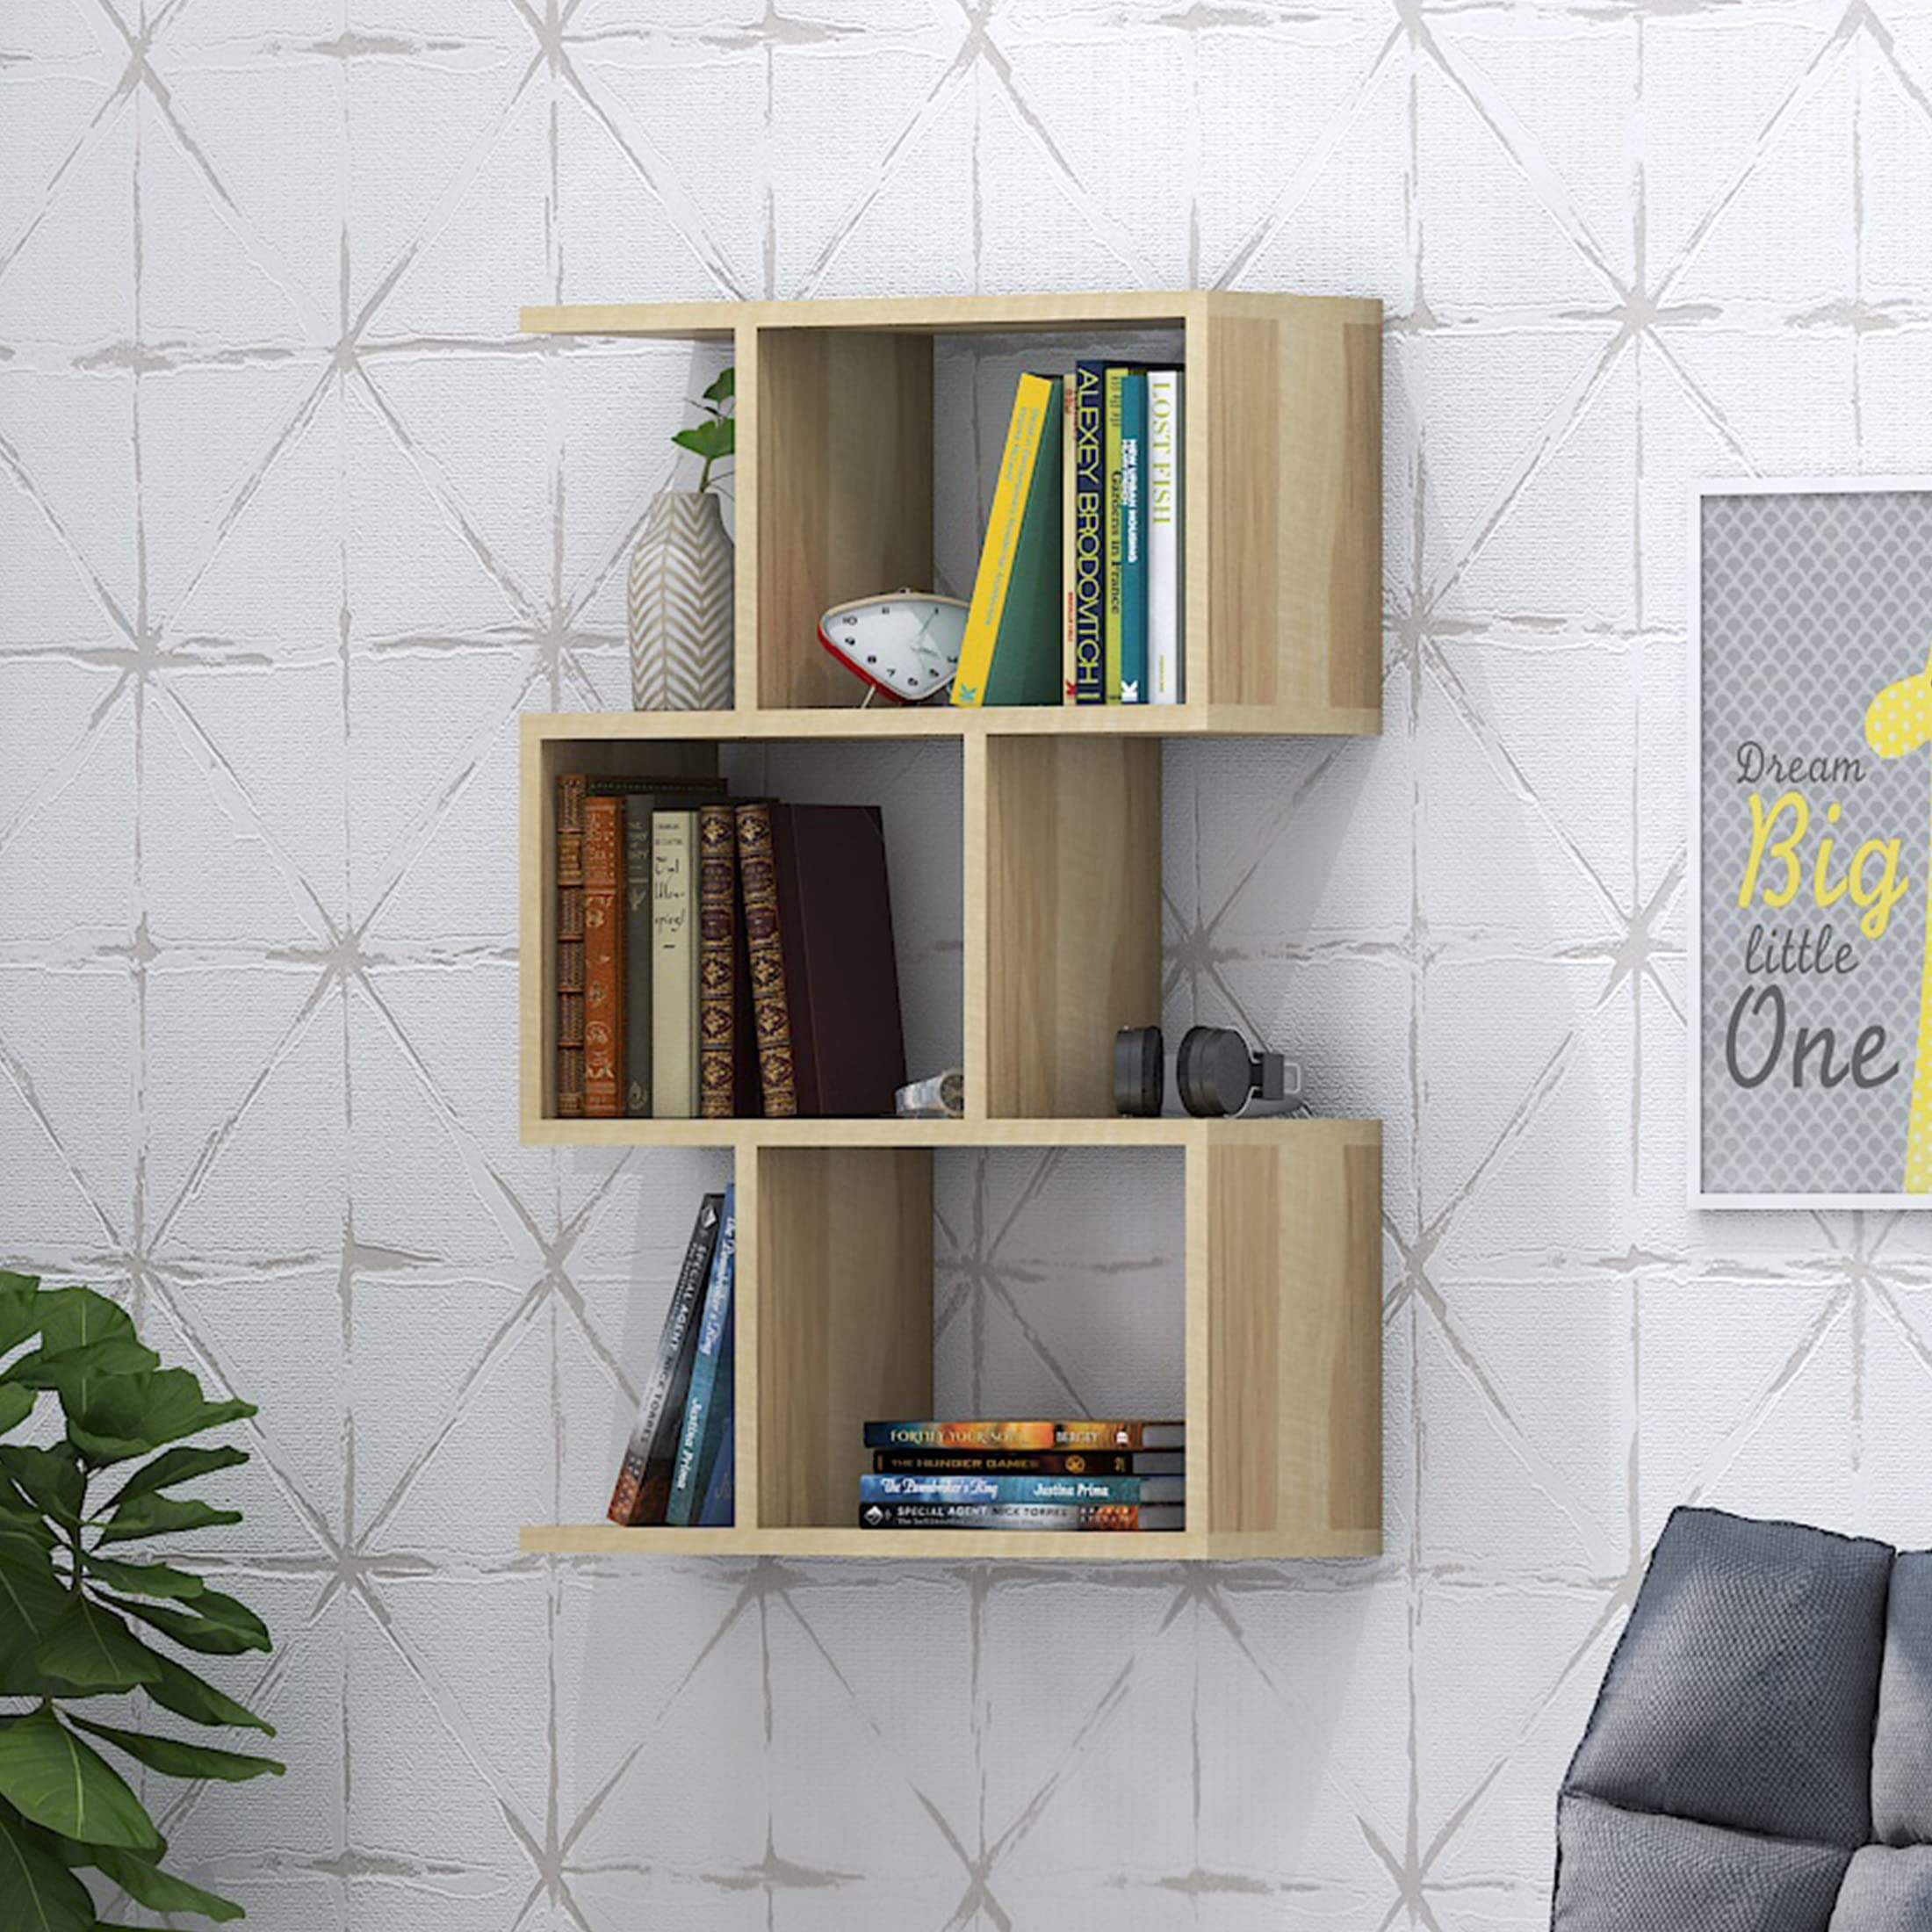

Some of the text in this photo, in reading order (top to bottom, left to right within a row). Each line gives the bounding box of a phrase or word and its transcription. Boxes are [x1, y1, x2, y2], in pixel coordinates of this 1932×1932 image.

[1152, 382, 1171, 524] LOST FISH
[1078, 368, 1099, 683] ALEXEY BRODOVITCH
[1736, 740, 1866, 785] Dream
[1737, 791, 1909, 941] Big
[1745, 923, 1859, 975] little
[1726, 984, 1900, 1090] One
[684, 1244, 707, 1300] SPECIAL
[670, 1303, 689, 1351] AGENT
[891, 1459, 913, 1468] THE
[897, 1505, 944, 1517] SPECIAL
[948, 1505, 986, 1517] AGENT
